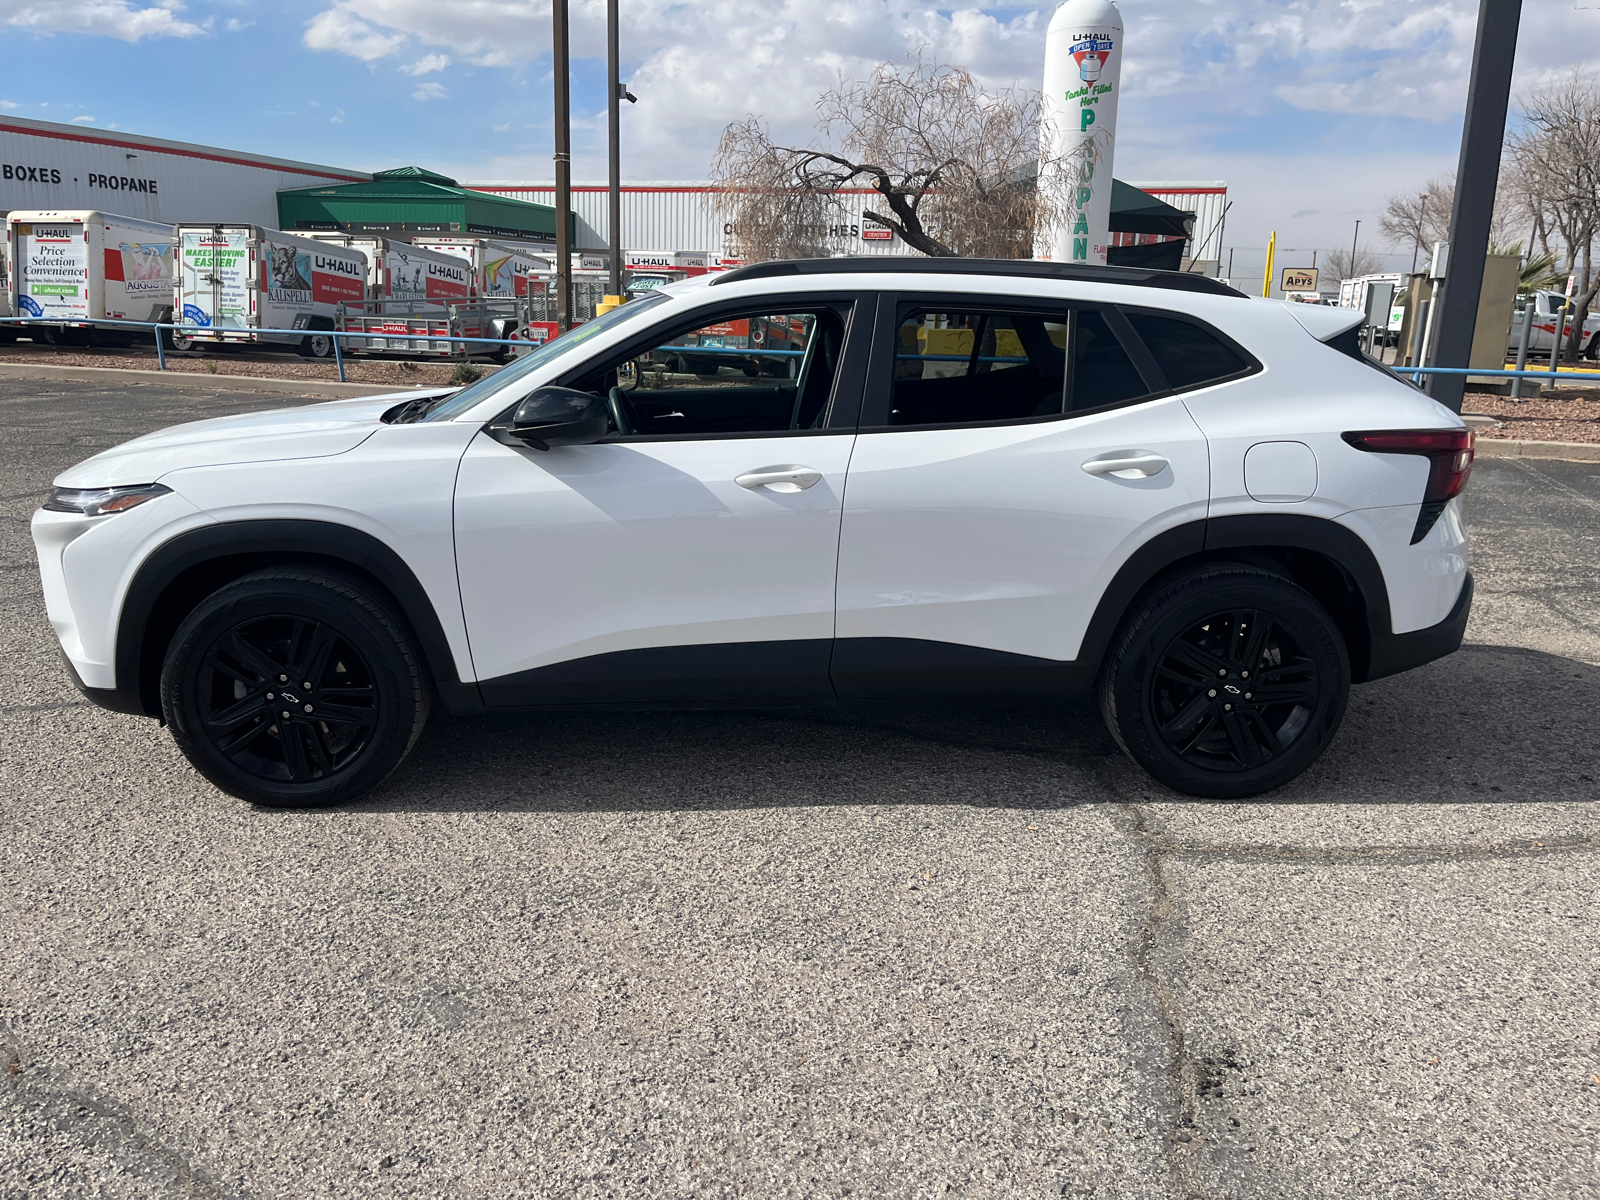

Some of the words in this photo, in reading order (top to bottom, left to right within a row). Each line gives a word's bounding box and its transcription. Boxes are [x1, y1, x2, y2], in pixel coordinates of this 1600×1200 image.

[1073, 33, 1111, 41] U-HAUL
[1073, 43, 1090, 52] OPEN
[1097, 42, 1110, 50] DAYS
[1065, 86, 1089, 101] Tanks
[1092, 82, 1113, 95] Filled
[1080, 96, 1099, 107] Here
[2, 164, 61, 184] BOXES
[88, 173, 158, 194] PROPANE
[36, 229, 71, 238] U-HAUL
[40, 245, 66, 255] Price
[185, 249, 212, 257] MAKES
[215, 249, 245, 257] MOVING
[31, 256, 75, 267] Selection
[194, 258, 237, 268] EASIER!
[315, 255, 360, 276] U-HAUL
[632, 258, 670, 266] U-HAUL
[687, 258, 704, 267] U-HAUL
[24, 265, 85, 276] Convenience
[428, 264, 464, 281] U-HAUL
[127, 280, 171, 290] AUGUSTA
[321, 284, 340, 292] ONE-WAY
[185, 305, 199, 313] LOWEST
[197, 312, 208, 324] DECKS
[193, 313, 202, 323] LOAD
